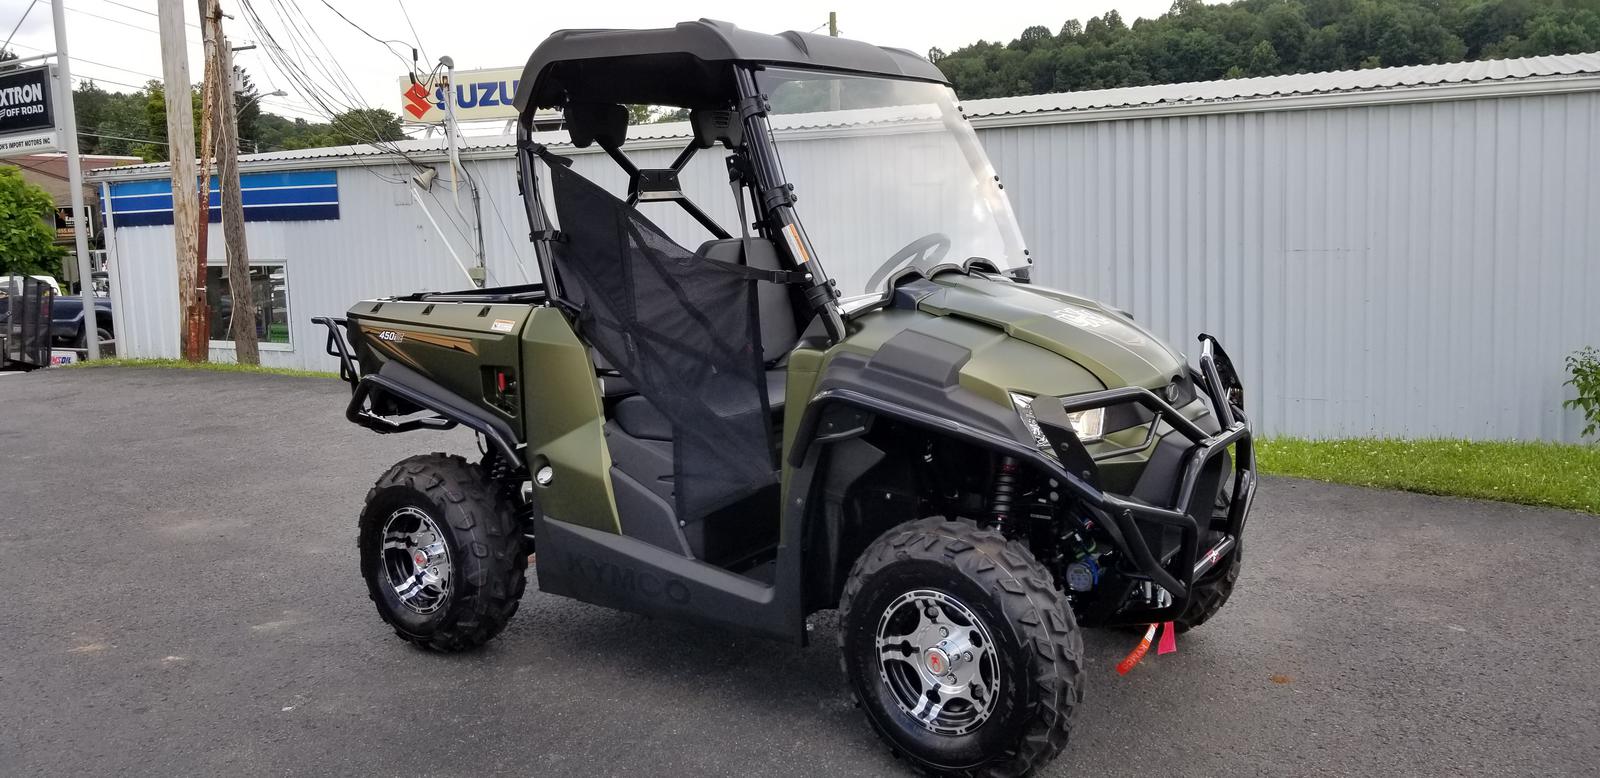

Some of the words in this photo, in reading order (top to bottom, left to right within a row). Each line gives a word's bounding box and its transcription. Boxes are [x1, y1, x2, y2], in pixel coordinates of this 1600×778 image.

[6, 108, 20, 117] OFF
[21, 104, 44, 115] ROAD
[9, 141, 24, 149] IMPORT
[566, 551, 692, 604] KYMCO
